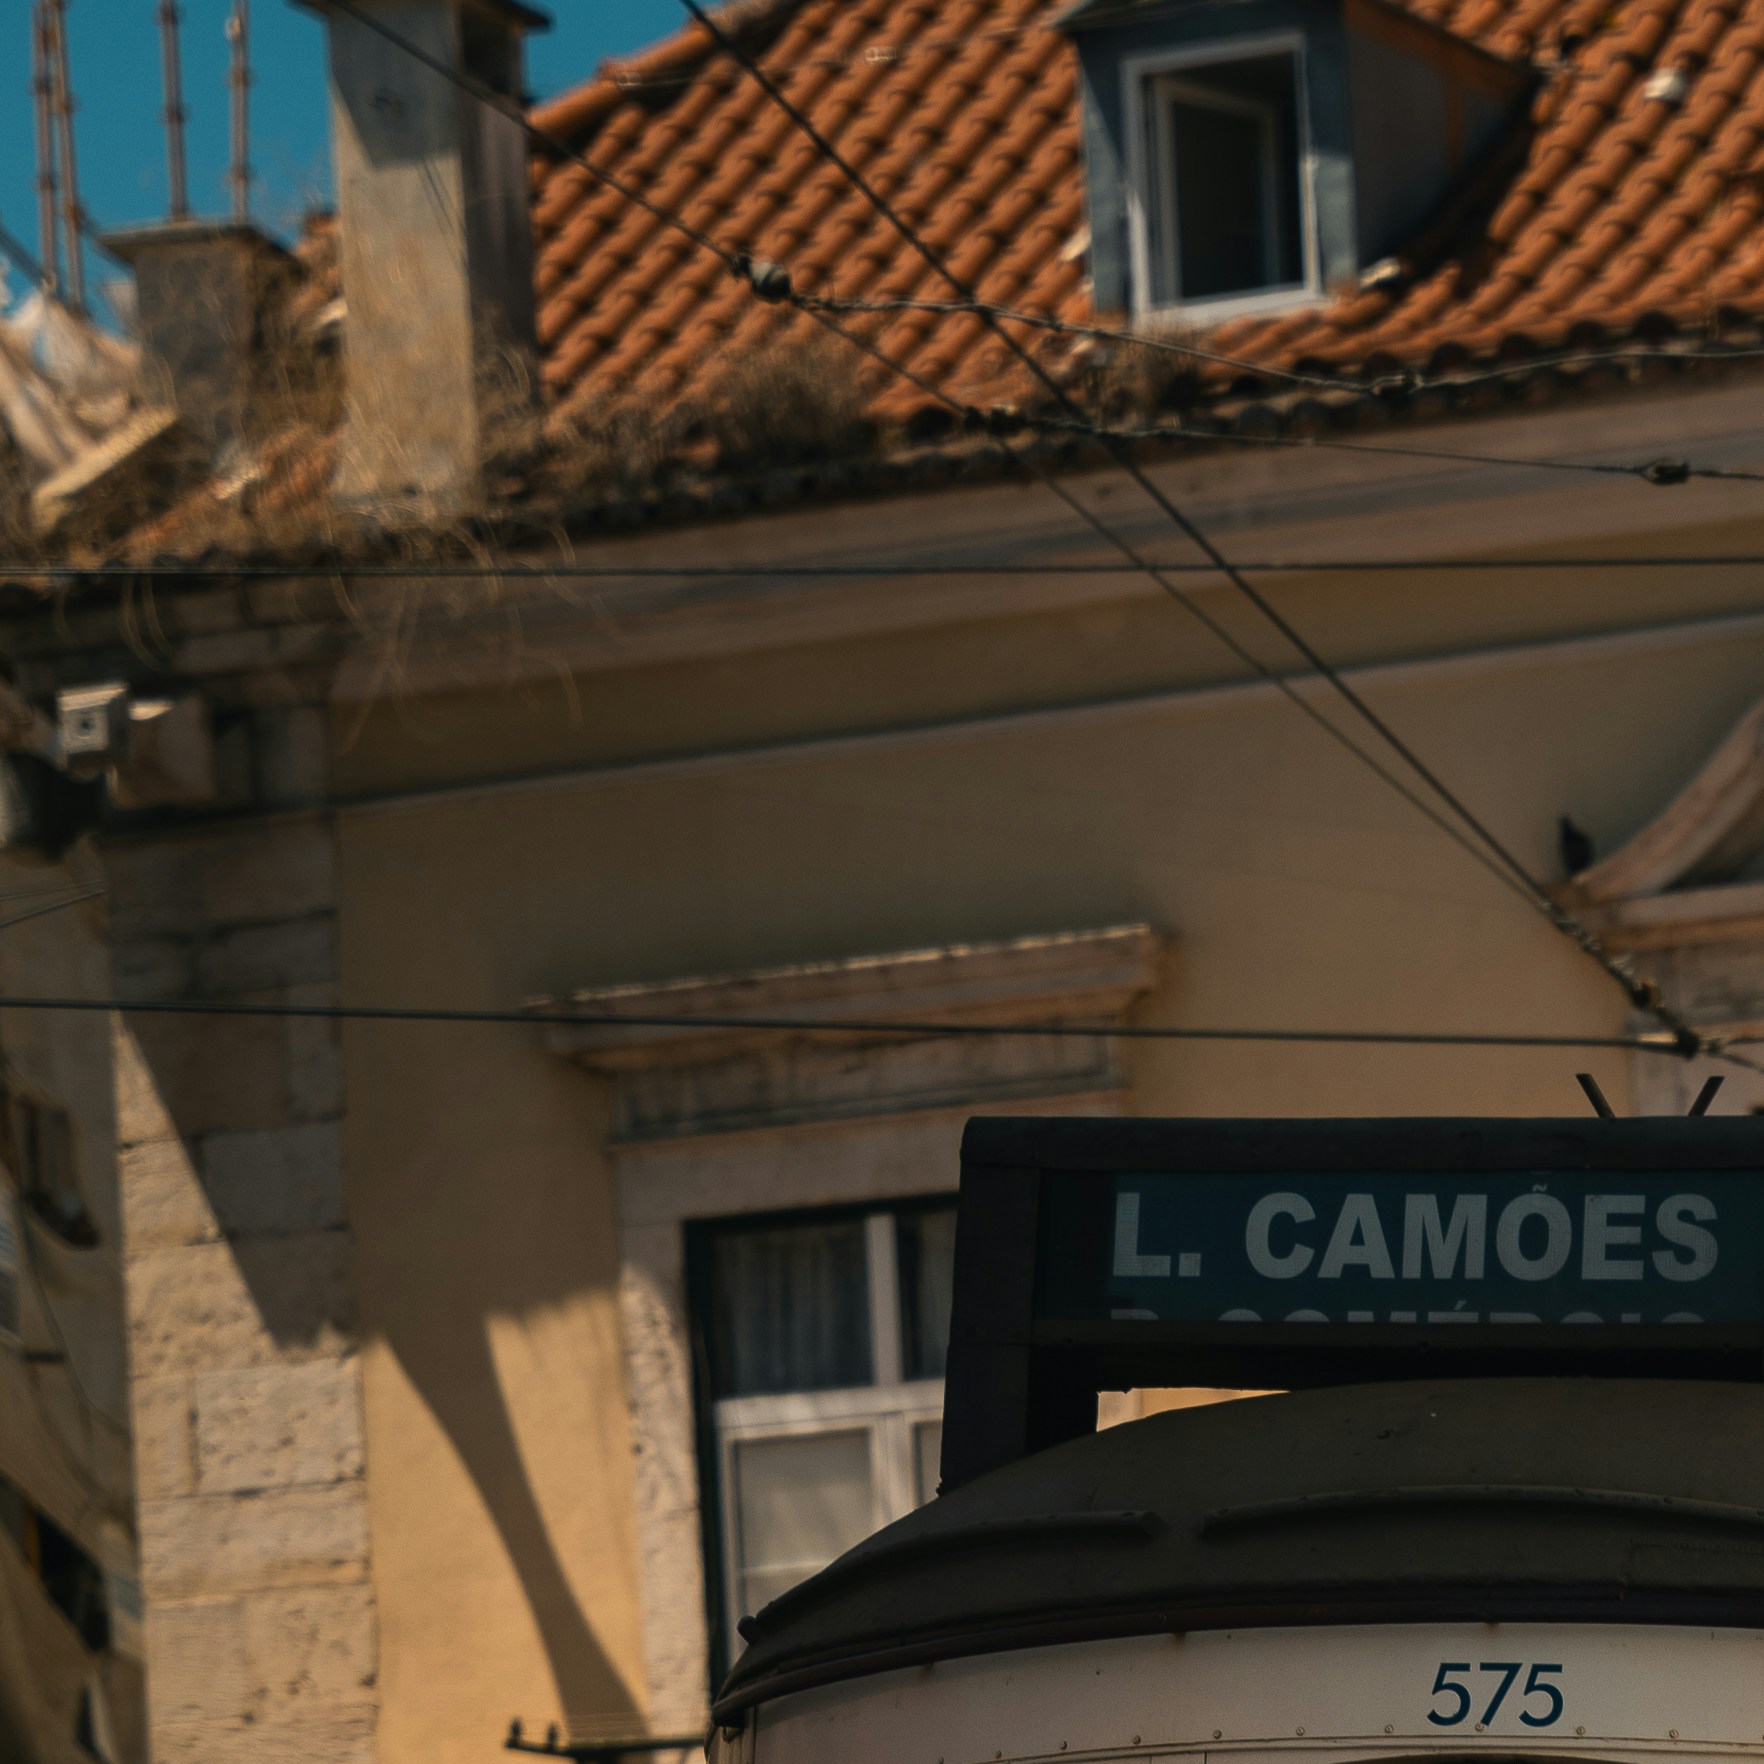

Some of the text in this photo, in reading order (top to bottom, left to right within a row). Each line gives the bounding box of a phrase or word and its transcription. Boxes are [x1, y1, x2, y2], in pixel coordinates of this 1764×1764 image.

[1110, 1181, 1720, 1283] L. CAMÕES
[1424, 1661, 1568, 1731] 575
